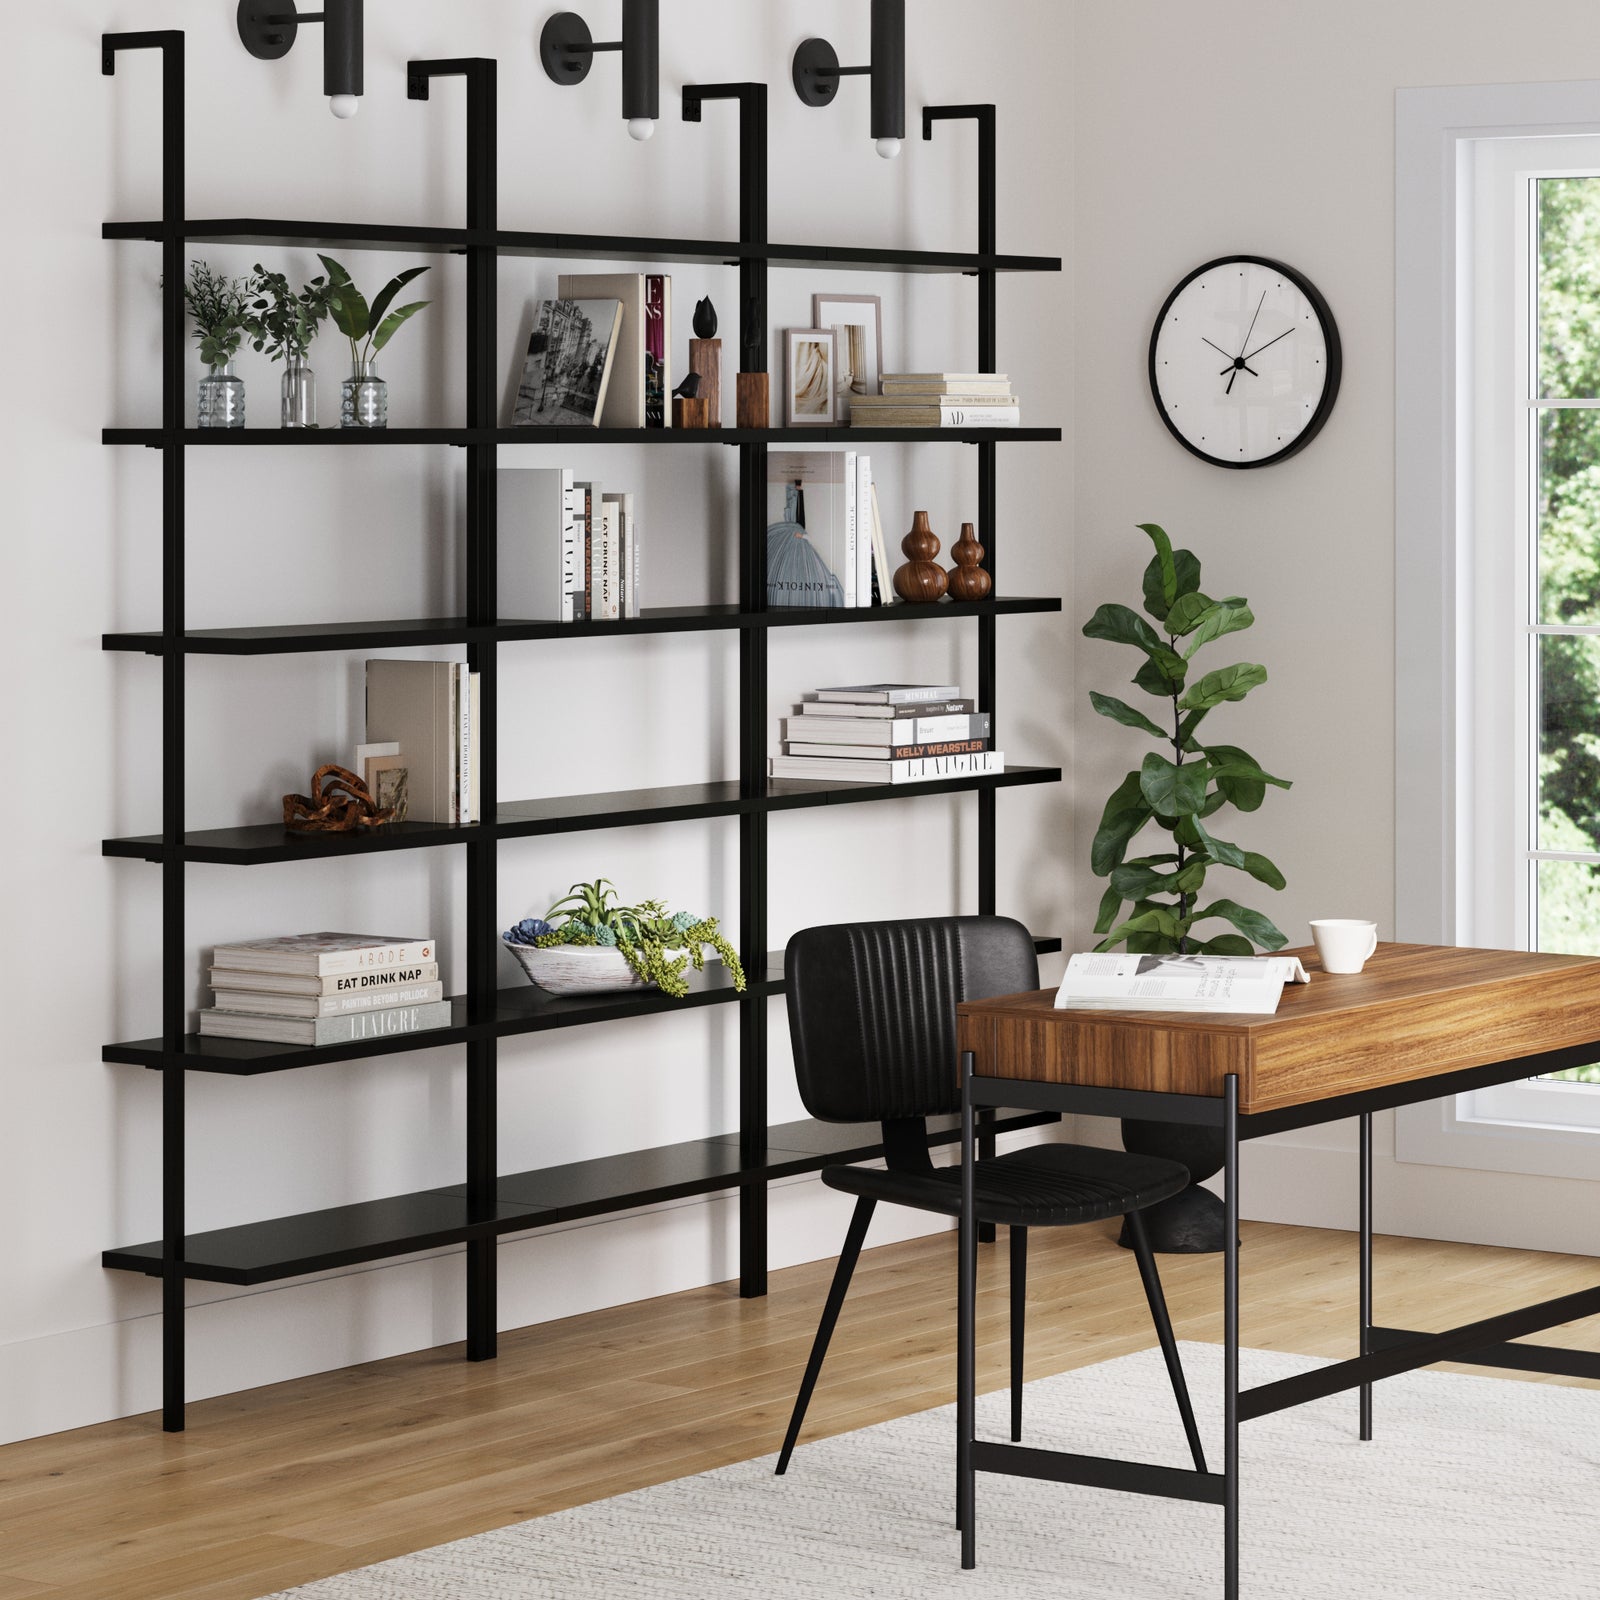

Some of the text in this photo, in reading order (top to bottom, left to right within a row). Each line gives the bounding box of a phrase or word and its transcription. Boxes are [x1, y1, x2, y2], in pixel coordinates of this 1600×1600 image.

[948, 411, 965, 425] AD
[777, 582, 824, 591] KINFOLK
[905, 690, 938, 700] MINIMAL
[945, 703, 964, 713] Nature
[896, 740, 983, 758] KELLY WEARSTLER
[358, 949, 406, 967] ABODE
[337, 969, 422, 991] EAT DRINK NAP
[341, 997, 372, 1009] PAINTING
[373, 993, 398, 1006] BEYOND
[400, 989, 429, 1002] POLLOCK
[350, 1007, 420, 1039] LIAIGRE
